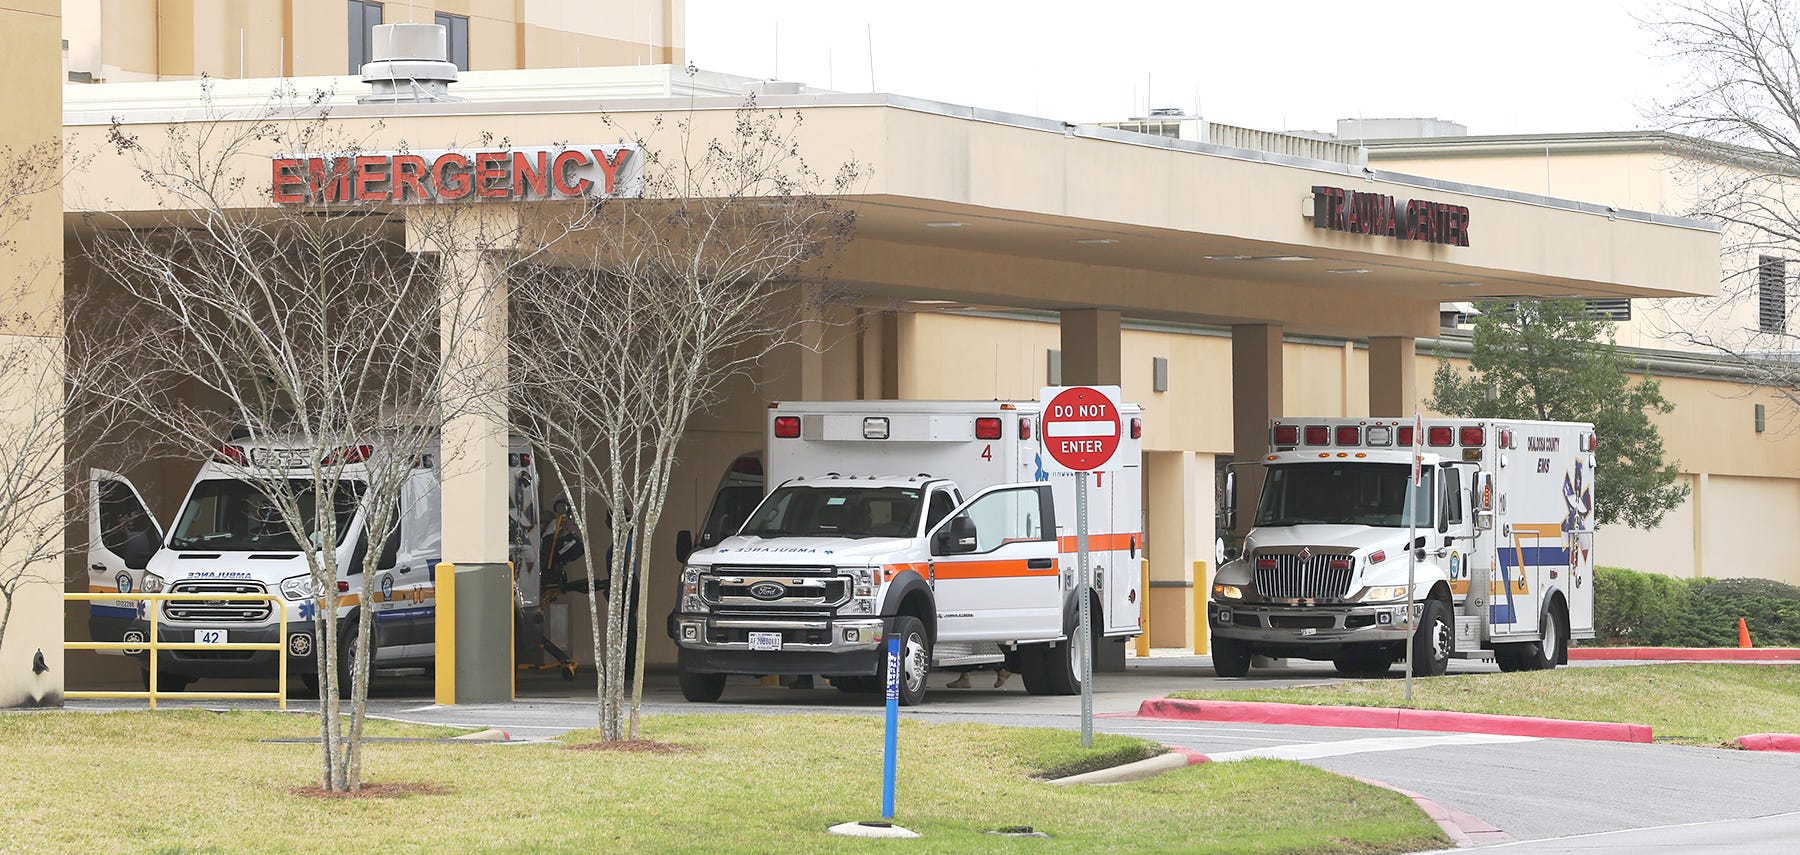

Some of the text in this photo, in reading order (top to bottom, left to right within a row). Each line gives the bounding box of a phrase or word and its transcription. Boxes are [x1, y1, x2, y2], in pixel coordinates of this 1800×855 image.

[272, 149, 633, 203] EMERGENCY
[1314, 185, 1470, 247] TRAUMA CENTER
[1054, 404, 1106, 417] DO NOT
[981, 444, 992, 461] 4
[1061, 440, 1103, 453] ENTER
[1537, 458, 1550, 473] EMS
[202, 632, 219, 643] 42
